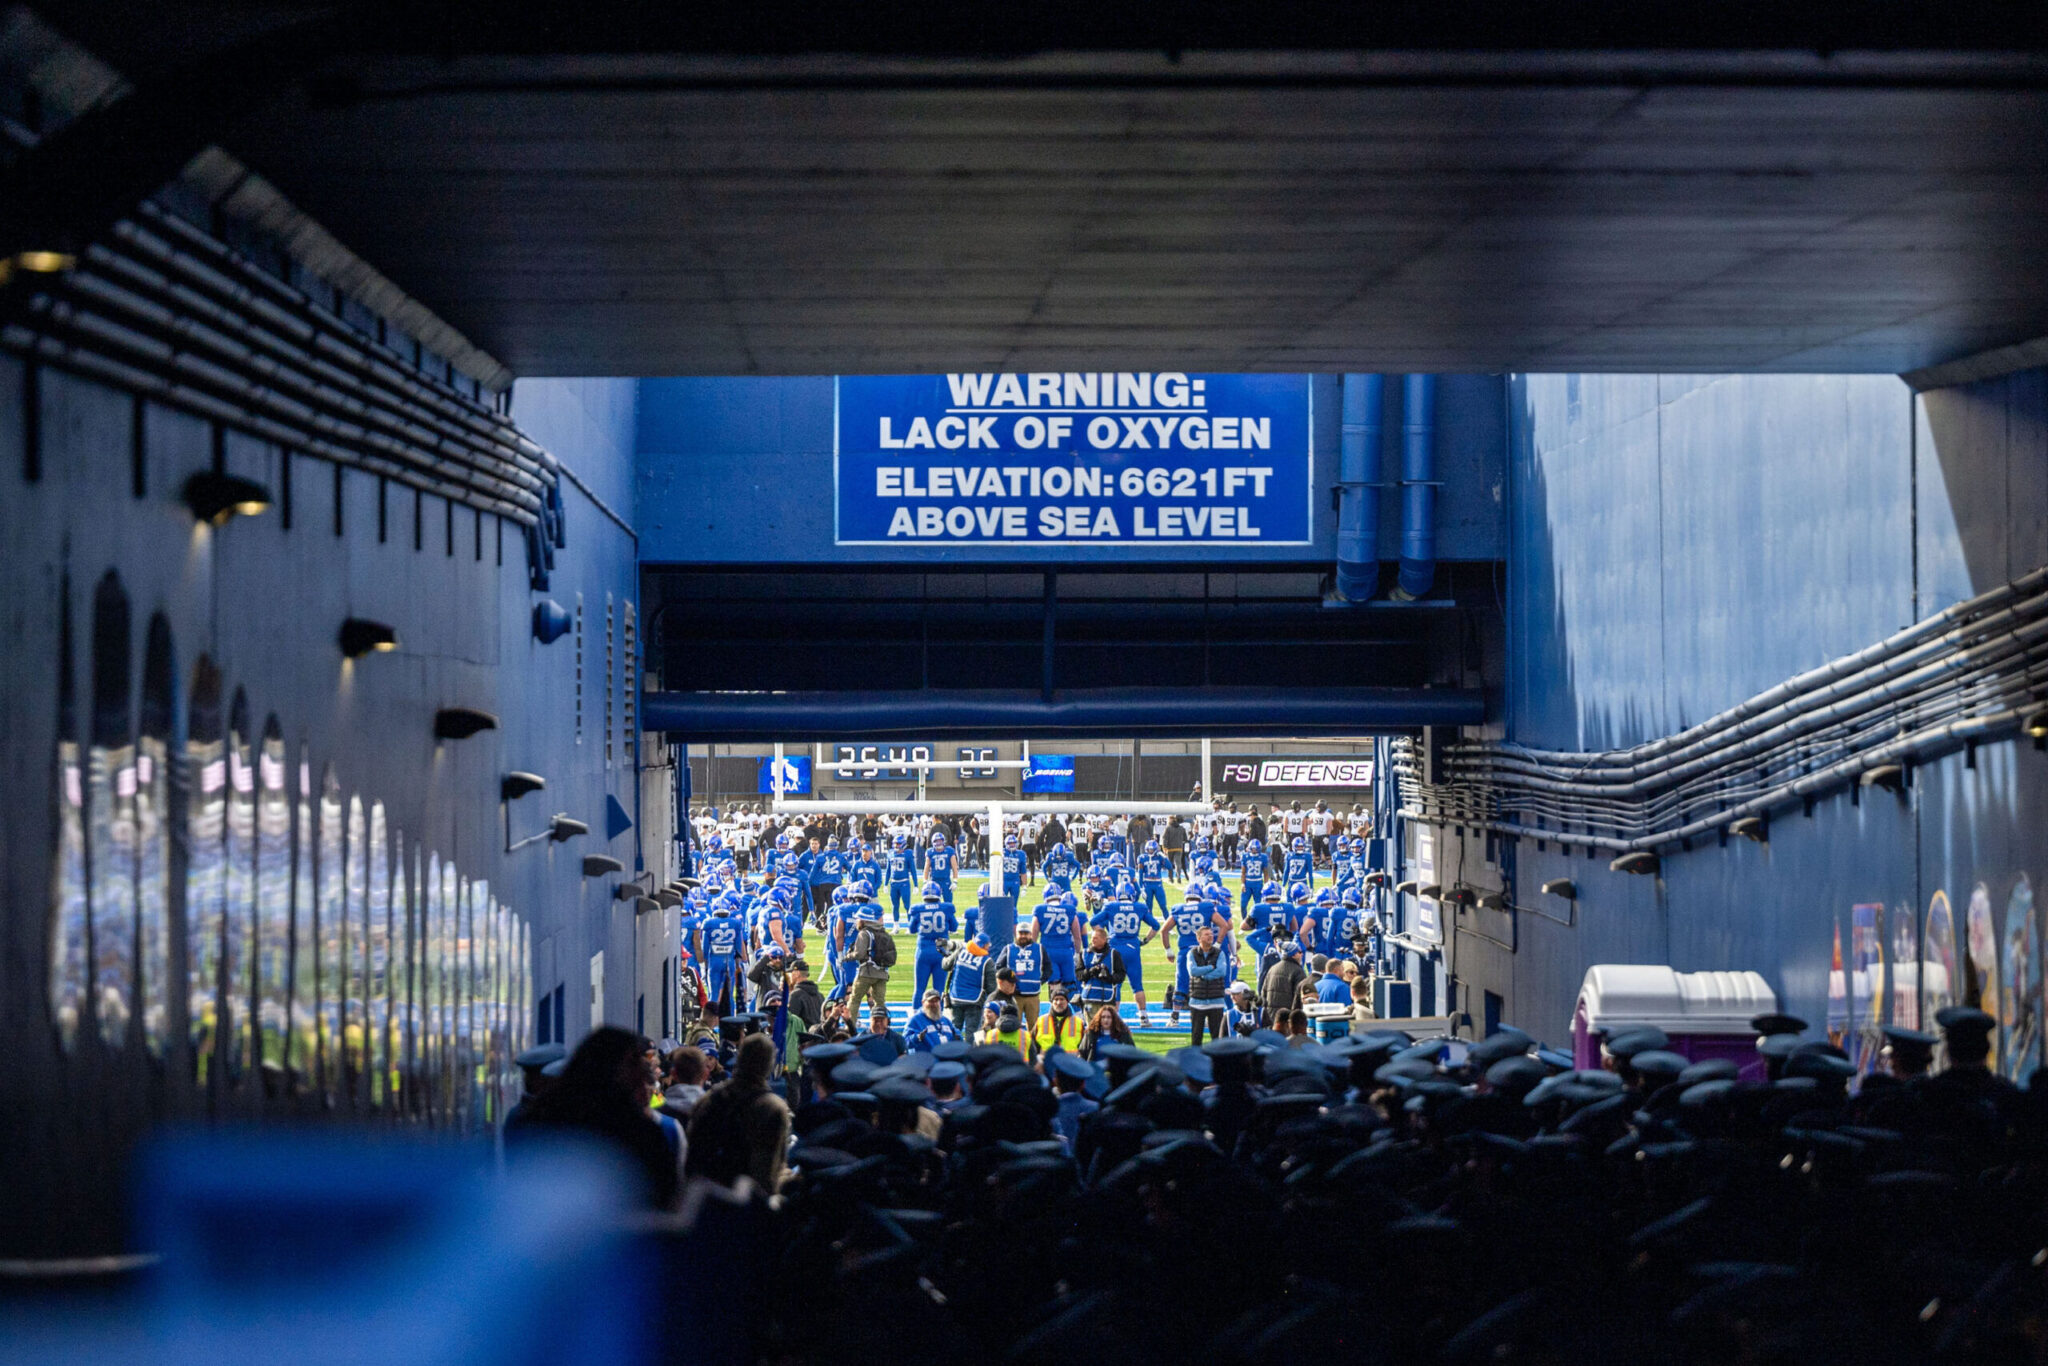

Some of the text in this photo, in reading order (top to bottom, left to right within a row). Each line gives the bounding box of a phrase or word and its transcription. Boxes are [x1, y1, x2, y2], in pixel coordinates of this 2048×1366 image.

[946, 372, 1206, 407] WARNING:
[879, 416, 1271, 449] LACK OF OXYGEN
[876, 467, 1273, 497] ELEVATION: 6621FT
[887, 506, 1261, 537] ABOVE SEA LEVEL
[1222, 764, 1257, 783] FSI
[1263, 765, 1369, 781] DEFENSE
[920, 911, 946, 933] 50
[1043, 912, 1069, 935] 73
[710, 928, 736, 943] 22
